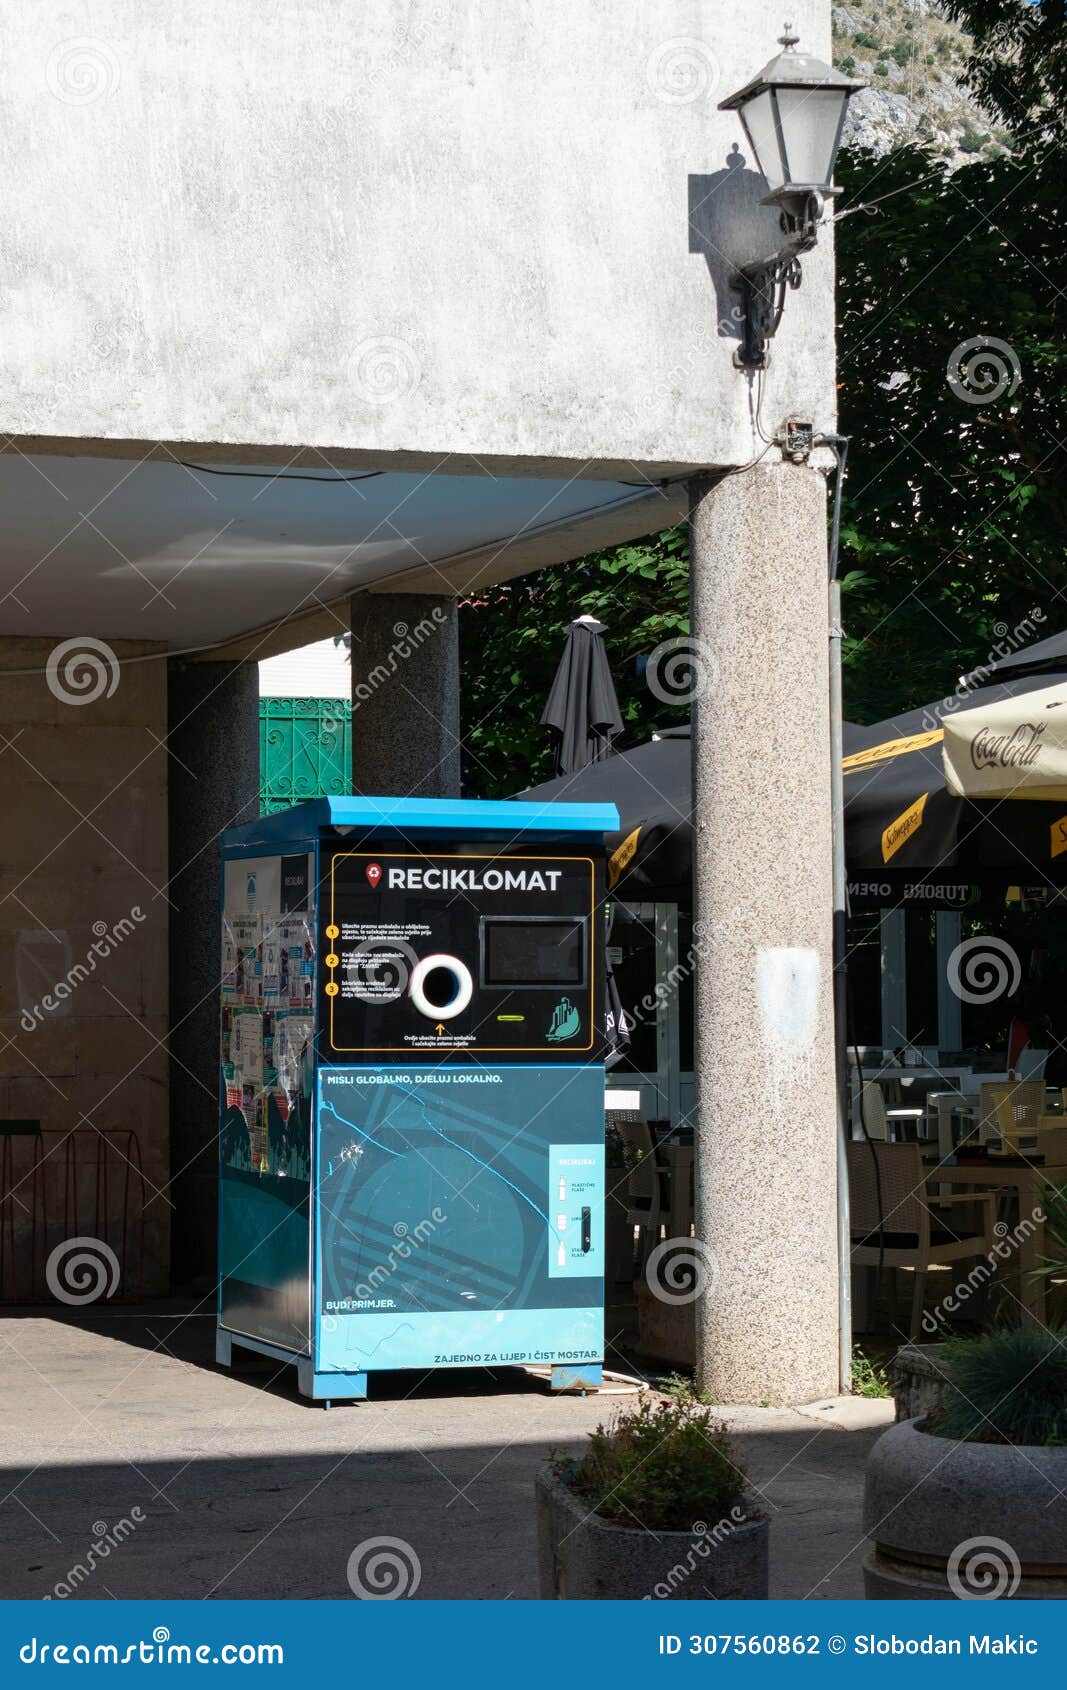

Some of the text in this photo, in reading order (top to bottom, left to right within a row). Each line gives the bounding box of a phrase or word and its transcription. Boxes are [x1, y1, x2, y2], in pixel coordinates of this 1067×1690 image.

[885, 808, 919, 849] Schweppes
[388, 868, 562, 890] RECIKLOMAT
[327, 1074, 503, 1086] MISLI GLOBALNO, DJELUJ LOKALNO.
[325, 1299, 397, 1310] BUDI PRIMJER.
[434, 1354, 482, 1364] ZAJEDNO
[484, 1353, 498, 1362] ZA
[500, 1352, 526, 1362] LIJEP
[534, 1349, 555, 1361] ČIST
[558, 1350, 602, 1361] MOSTAR.
